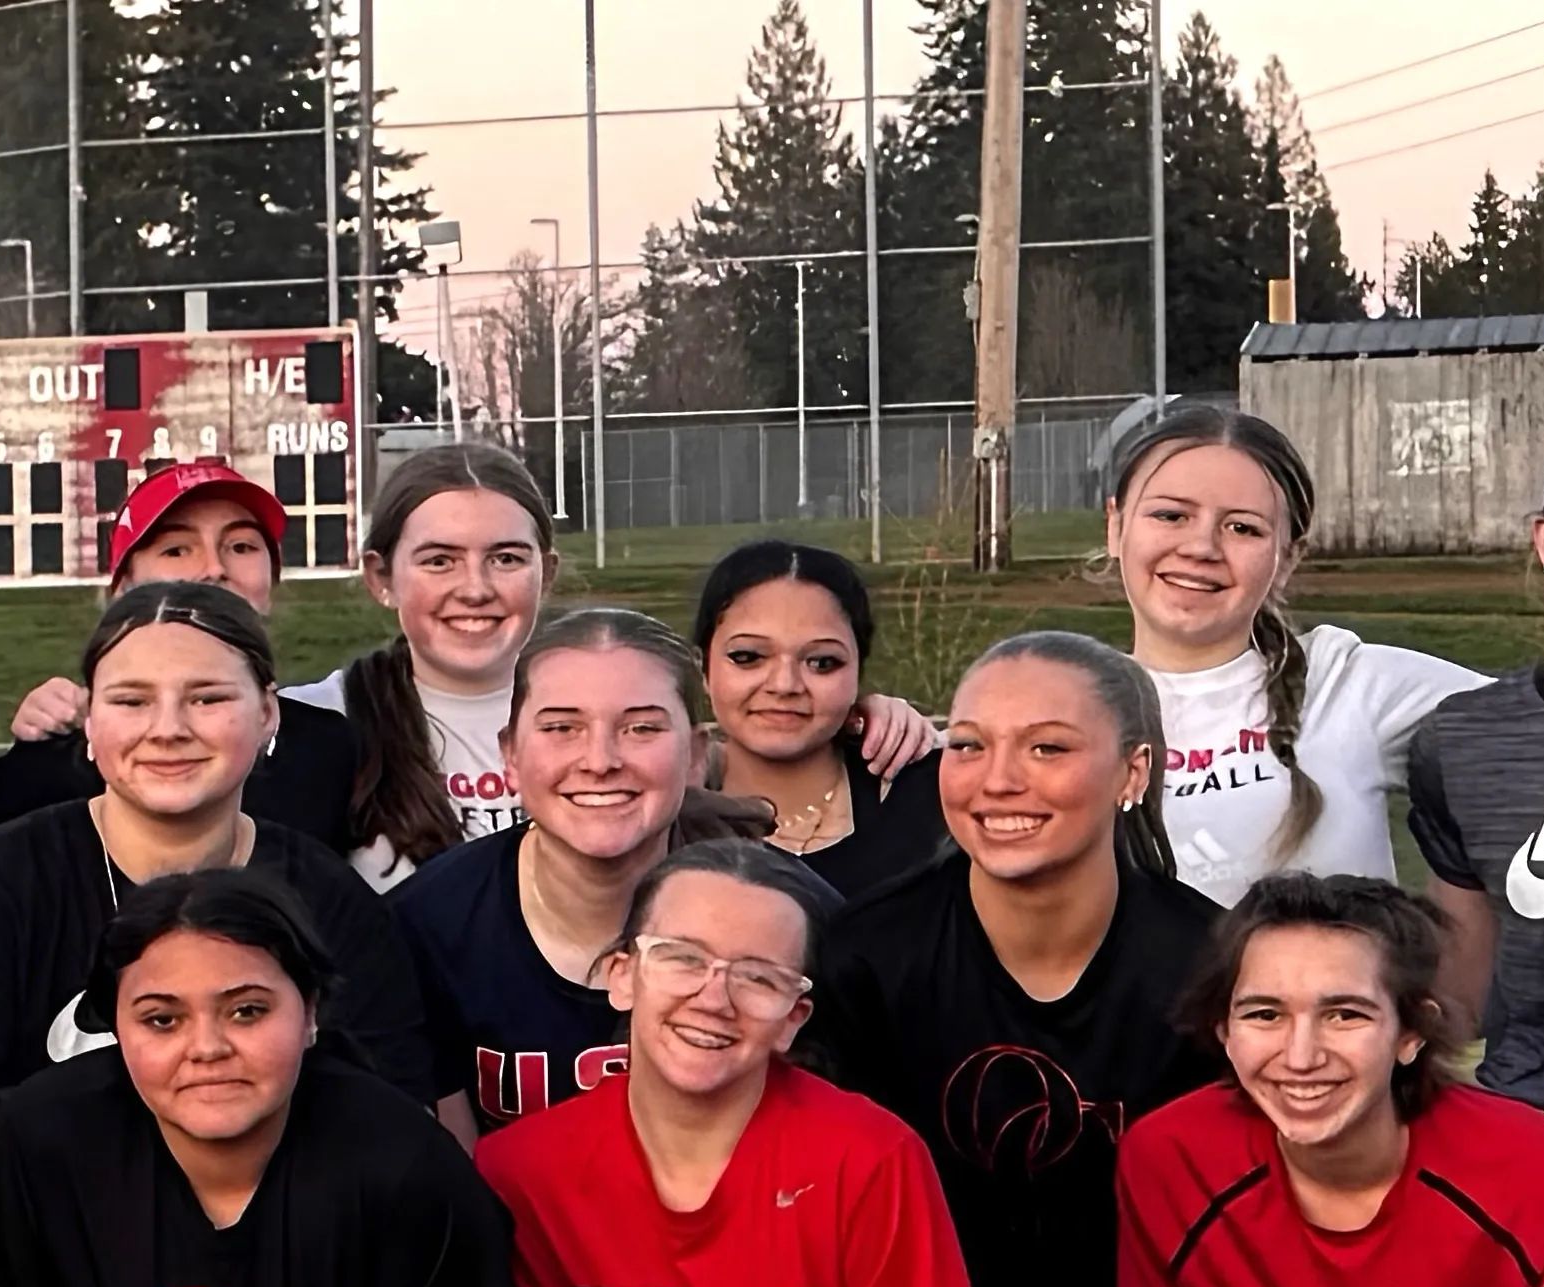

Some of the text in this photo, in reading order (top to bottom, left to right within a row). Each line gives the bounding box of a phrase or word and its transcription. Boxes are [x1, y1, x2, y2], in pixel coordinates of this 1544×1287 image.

[29, 364, 104, 402] OUT
[244, 357, 306, 397] H/E
[37, 431, 55, 463] 6
[105, 428, 122, 459] 7
[153, 427, 170, 458] 8
[200, 425, 217, 456] 9
[268, 420, 349, 453] RUNS
